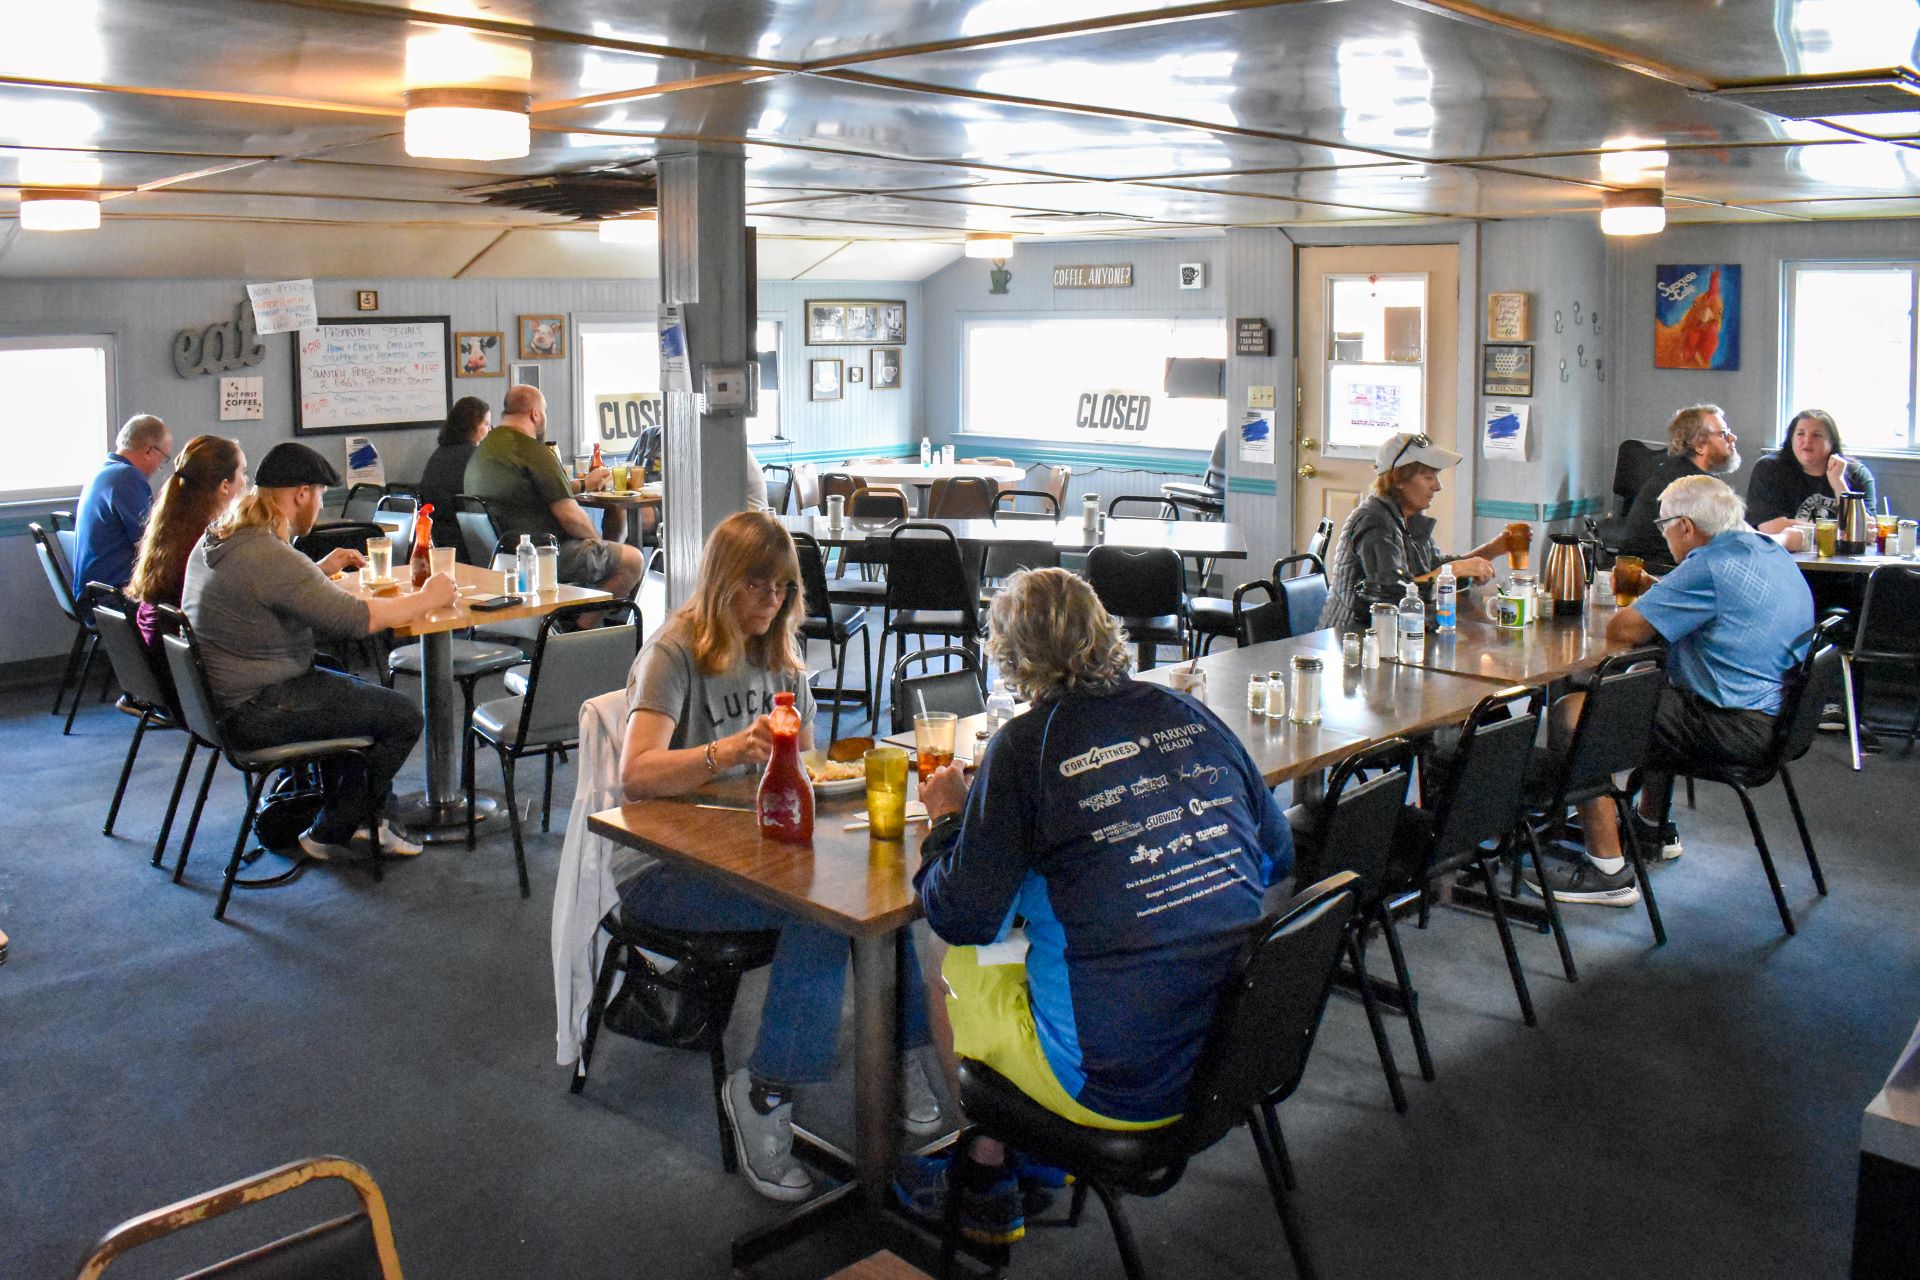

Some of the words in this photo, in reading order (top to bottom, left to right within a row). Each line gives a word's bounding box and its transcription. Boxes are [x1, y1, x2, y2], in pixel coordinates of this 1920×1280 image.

[1054, 269, 1087, 286] COFFEE,
[1088, 267, 1132, 285] ANYONE?
[172, 299, 266, 380] eat
[599, 399, 661, 440] CLOSE
[1076, 392, 1151, 431] CLOSED
[1152, 722, 1207, 744] PARKVIEW
[1159, 737, 1194, 754] HEALTH
[1146, 808, 1183, 830] SUBWAY
[1137, 903, 1168, 918] Huntington
